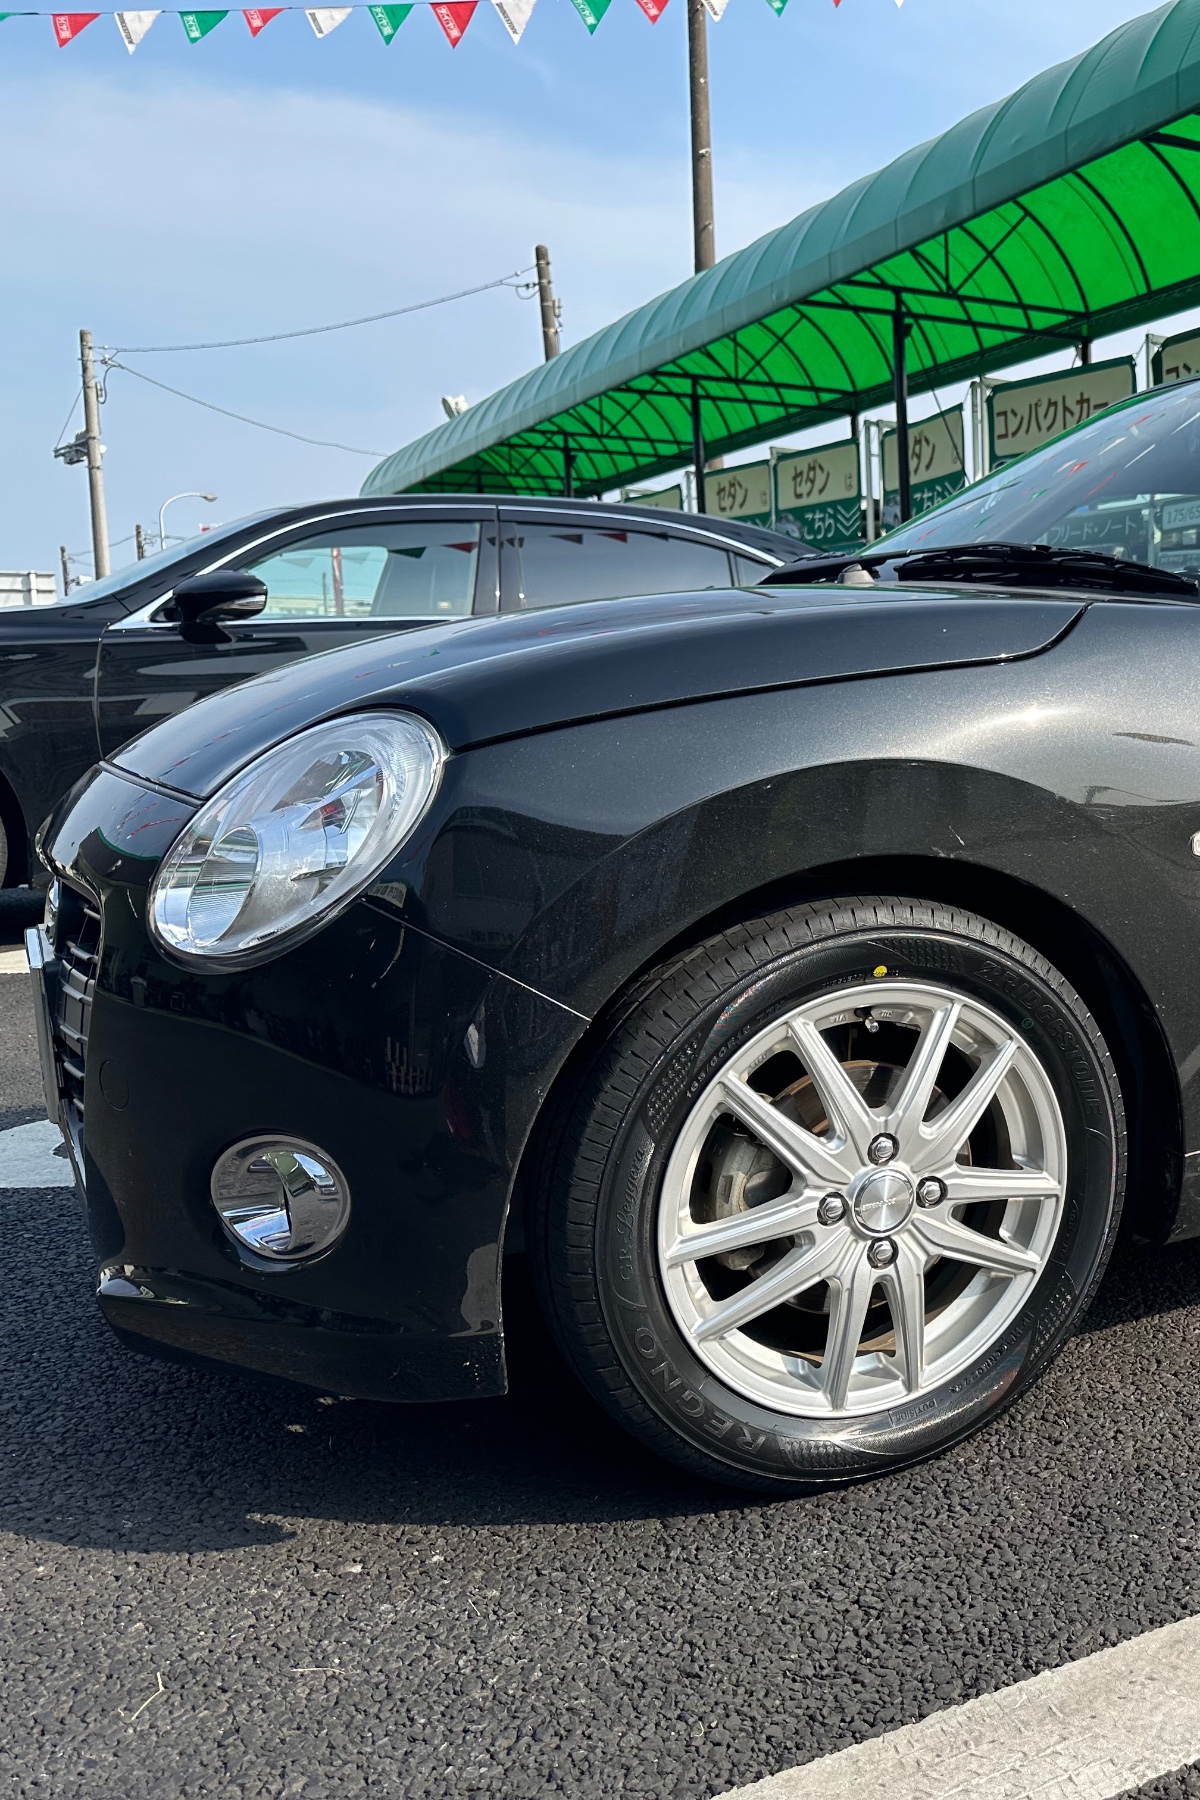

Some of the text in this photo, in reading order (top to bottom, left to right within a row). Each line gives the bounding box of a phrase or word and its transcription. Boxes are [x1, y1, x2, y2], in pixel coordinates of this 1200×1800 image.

[716, 476, 748, 513] セダン
[791, 459, 831, 500] セダン
[803, 505, 836, 541] こちら
[634, 1326, 767, 1455] REGNO
